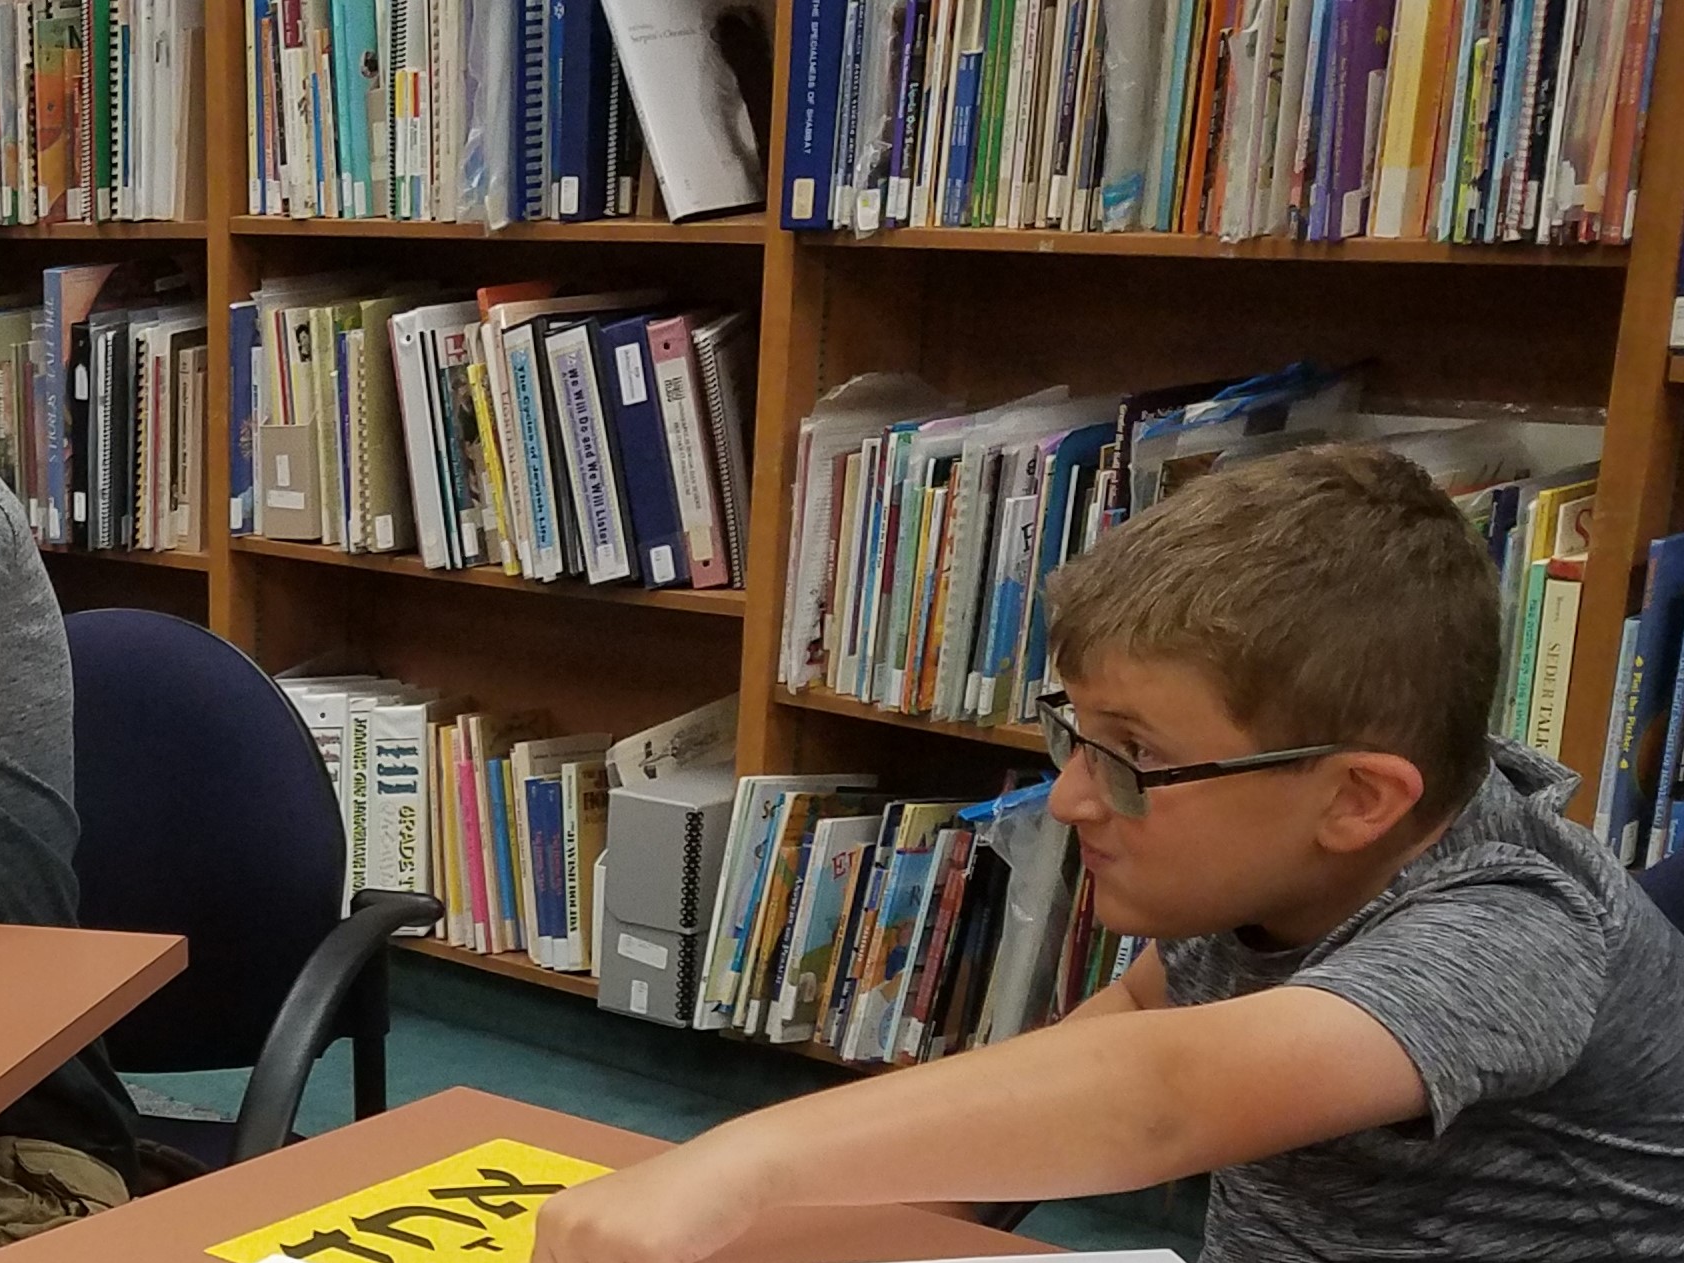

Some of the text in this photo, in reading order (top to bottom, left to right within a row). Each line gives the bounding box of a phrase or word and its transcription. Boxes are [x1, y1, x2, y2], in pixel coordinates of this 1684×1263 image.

[807, 22, 819, 88] SPECIALNESS
[807, 91, 815, 105] OF
[804, 108, 814, 154] SHABBAT
[568, 367, 579, 387] We
[573, 389, 588, 415] Will
[578, 415, 589, 433] Do
[516, 365, 548, 543] The Cycles of Jewish Life
[581, 434, 596, 459] and
[587, 460, 599, 480] We
[591, 481, 605, 506] Will
[1535, 643, 1561, 749] SEDER TALK
[1628, 695, 1639, 713] the
[354, 772, 367, 799] AND
[398, 805, 416, 873] GRADE
[567, 830, 576, 882] JEWISH
